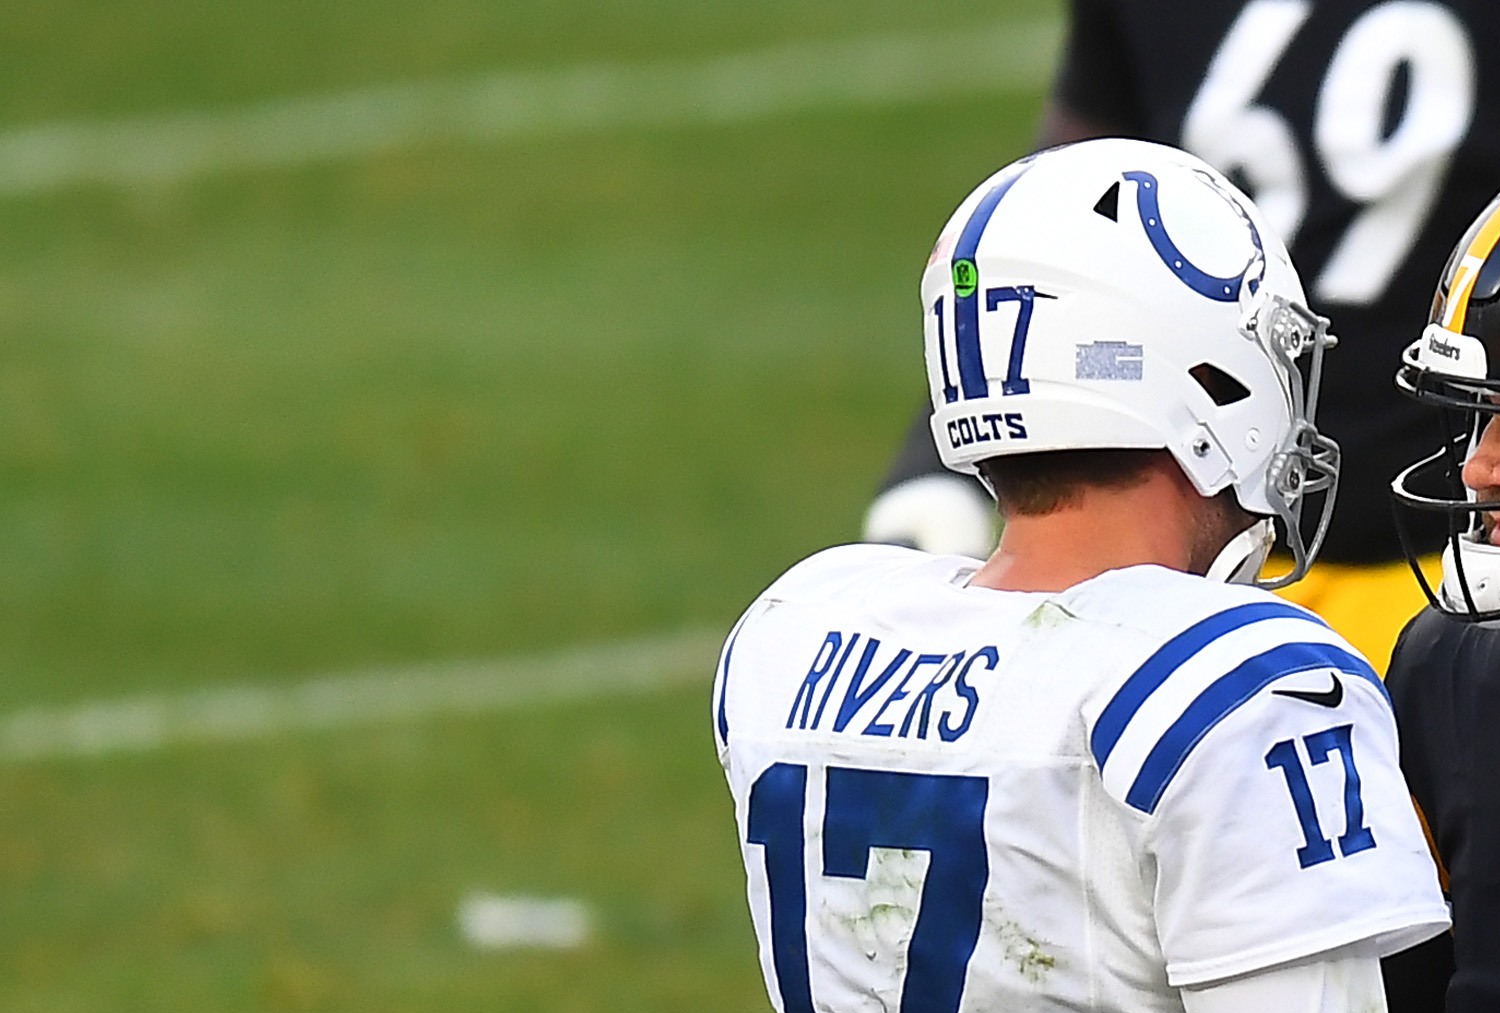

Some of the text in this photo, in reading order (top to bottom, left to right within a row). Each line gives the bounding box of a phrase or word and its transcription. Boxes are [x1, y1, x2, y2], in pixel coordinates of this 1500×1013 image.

[1180, 0, 1476, 303] 69
[935, 285, 1035, 404] 17
[1442, 253, 1485, 328] 7
[947, 413, 1028, 449] COLTS
[786, 631, 999, 742] RIVERS
[1265, 724, 1377, 869] 17
